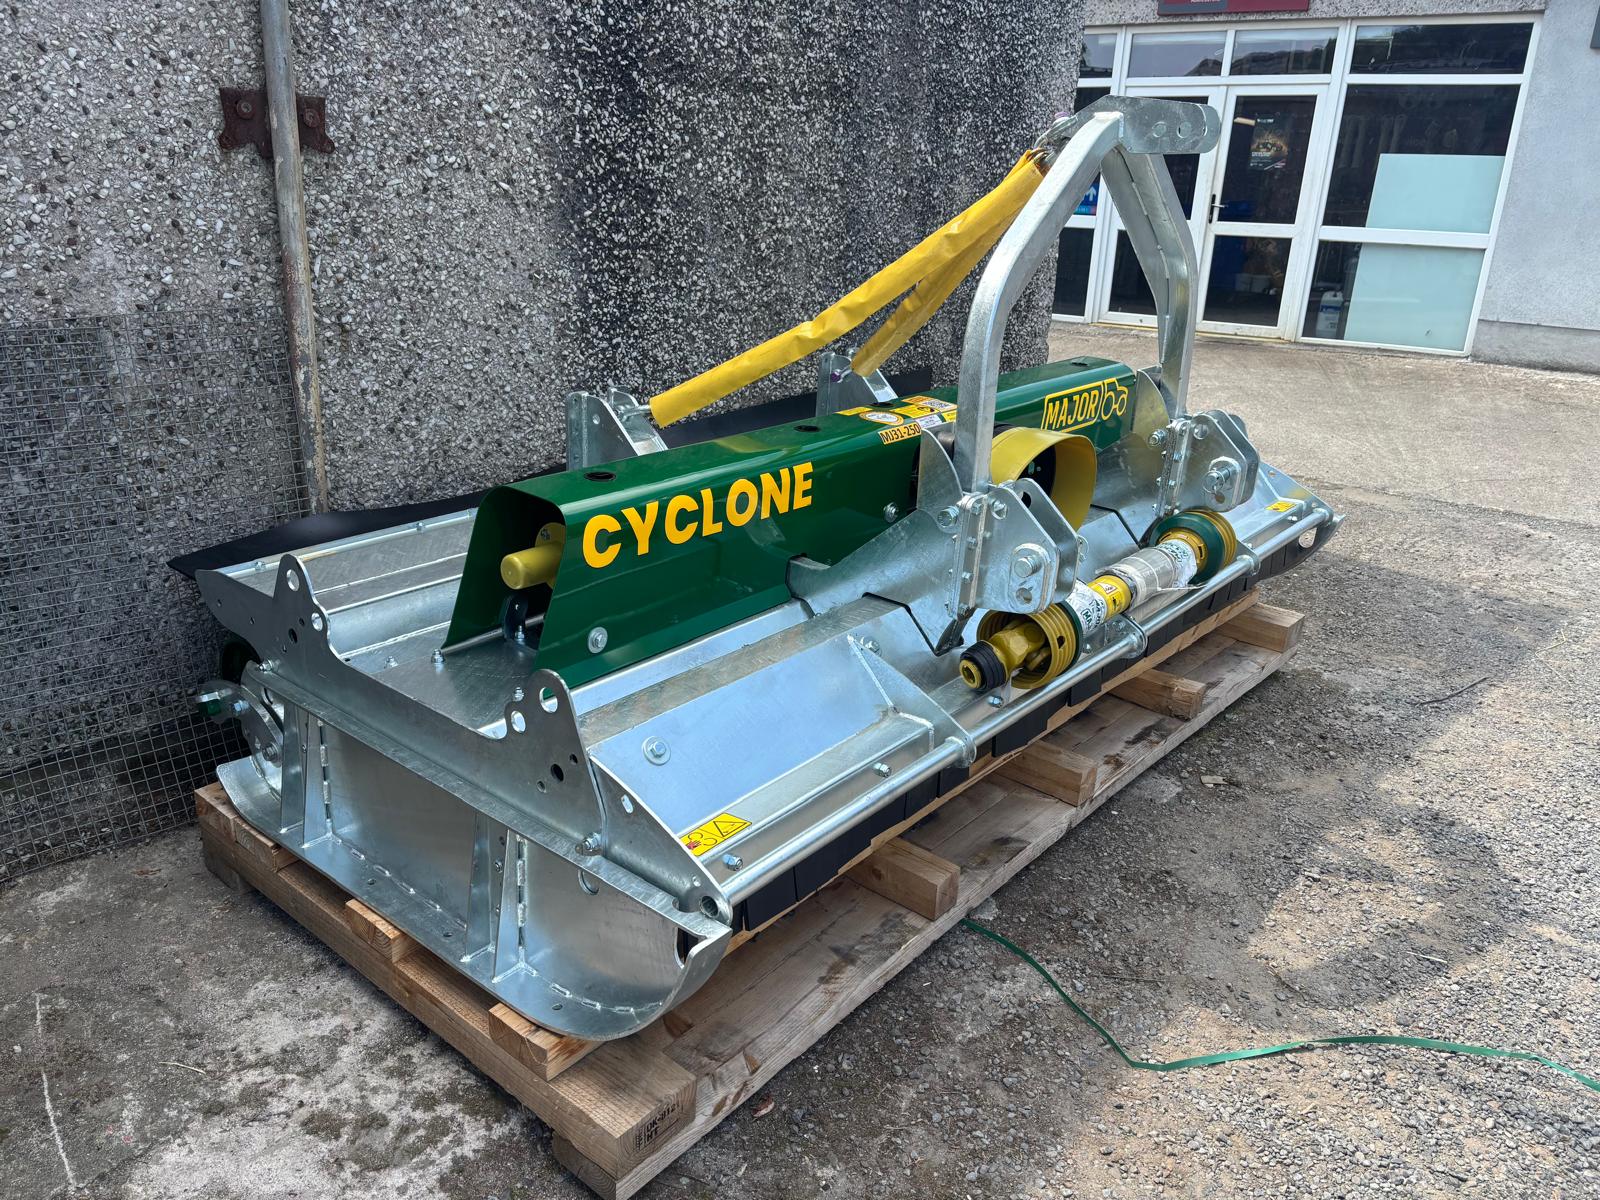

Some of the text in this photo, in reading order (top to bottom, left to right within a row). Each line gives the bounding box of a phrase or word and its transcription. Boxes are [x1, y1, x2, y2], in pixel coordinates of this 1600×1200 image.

[1045, 389, 1099, 431] MAJOR
[880, 423, 922, 444] MJ31-250
[583, 461, 813, 568] CYCLONE
